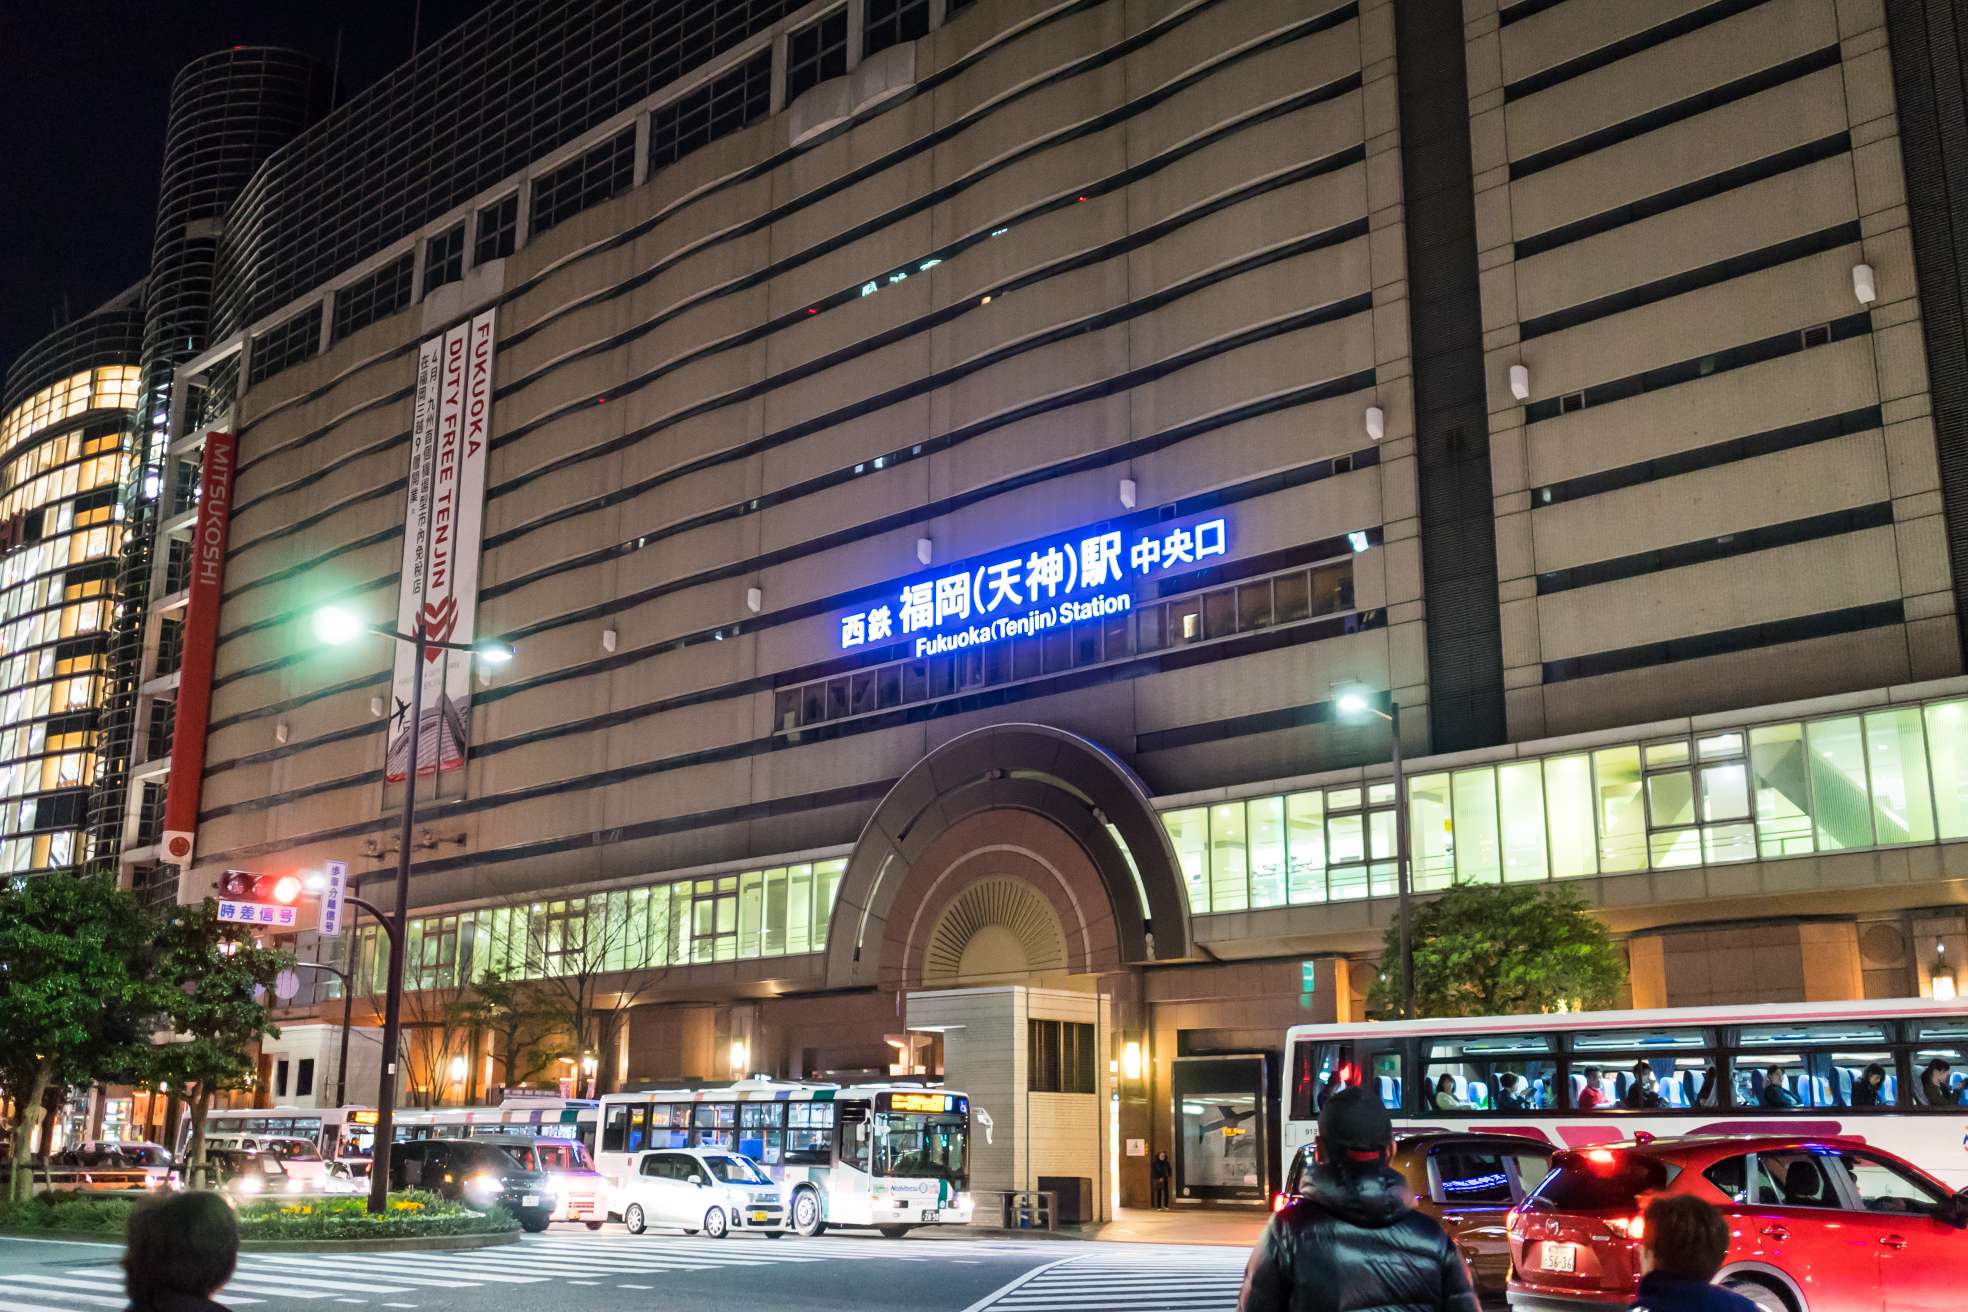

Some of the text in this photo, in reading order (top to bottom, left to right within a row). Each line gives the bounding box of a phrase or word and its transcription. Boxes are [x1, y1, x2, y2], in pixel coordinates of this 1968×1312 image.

[467, 322, 490, 458] FUKUOKA
[199, 443, 231, 585] MITSUKOSHI
[431, 337, 463, 588] DUTY FREE TENJIN
[841, 518, 1227, 649] 西鉄 福岡(天神)駅 中央口
[915, 592, 1131, 658] Fukuoka(Tenjin) Station
[220, 903, 293, 923] 時差信号
